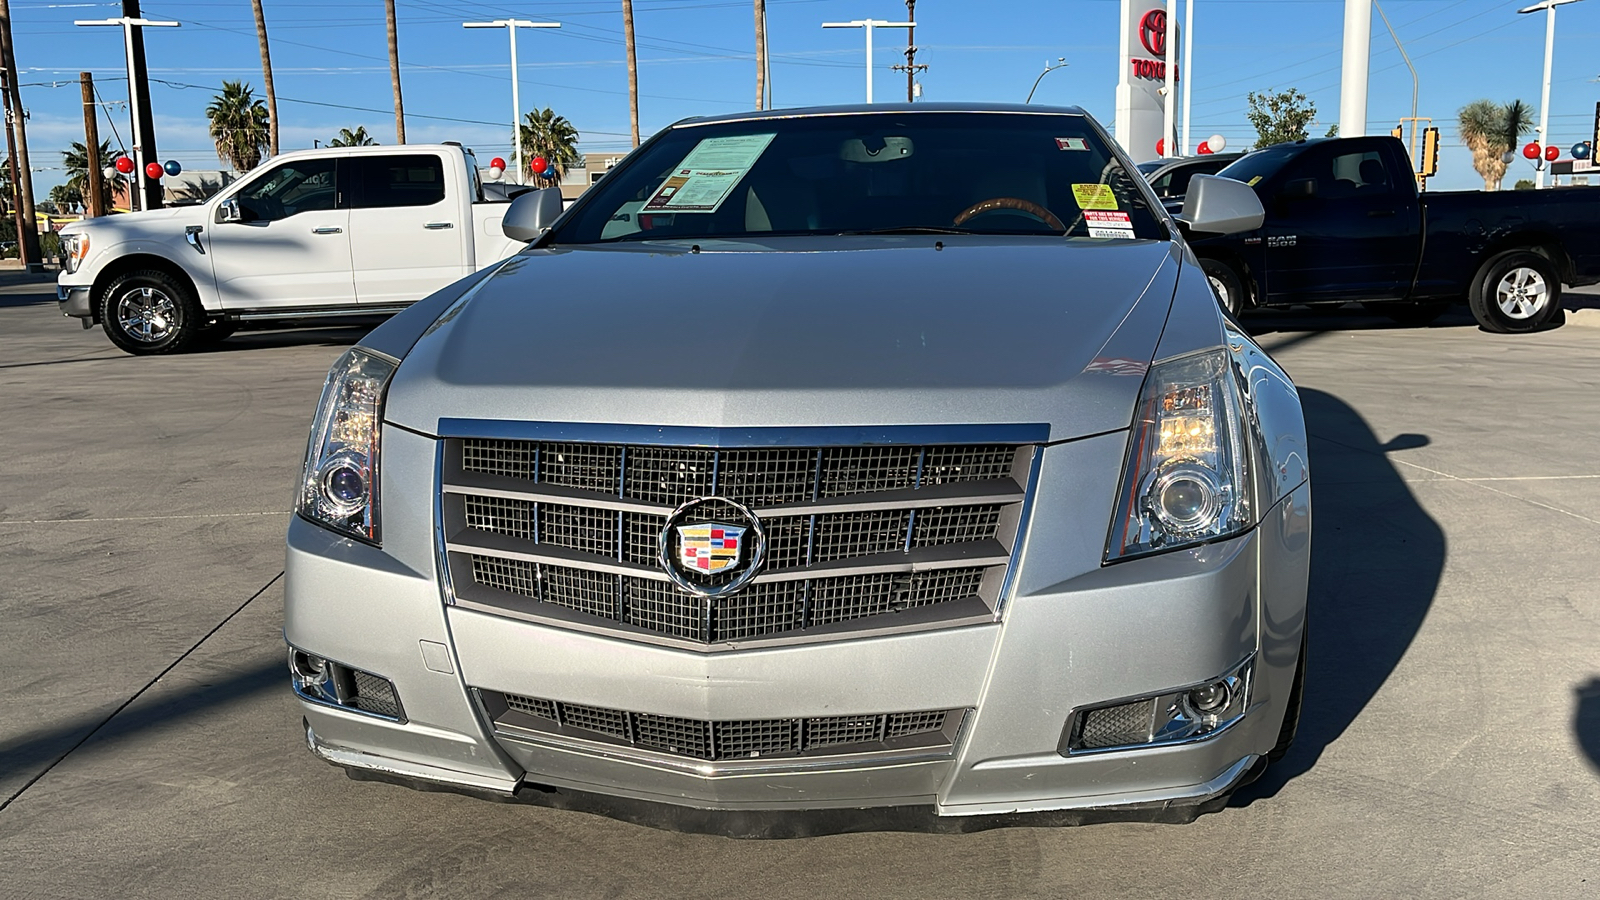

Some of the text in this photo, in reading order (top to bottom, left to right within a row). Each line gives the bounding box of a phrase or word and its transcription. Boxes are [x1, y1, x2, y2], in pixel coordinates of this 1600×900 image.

[1131, 58, 1179, 81] TOYOA
[1267, 234, 1297, 242] RAM
[1267, 240, 1297, 248] 1500
